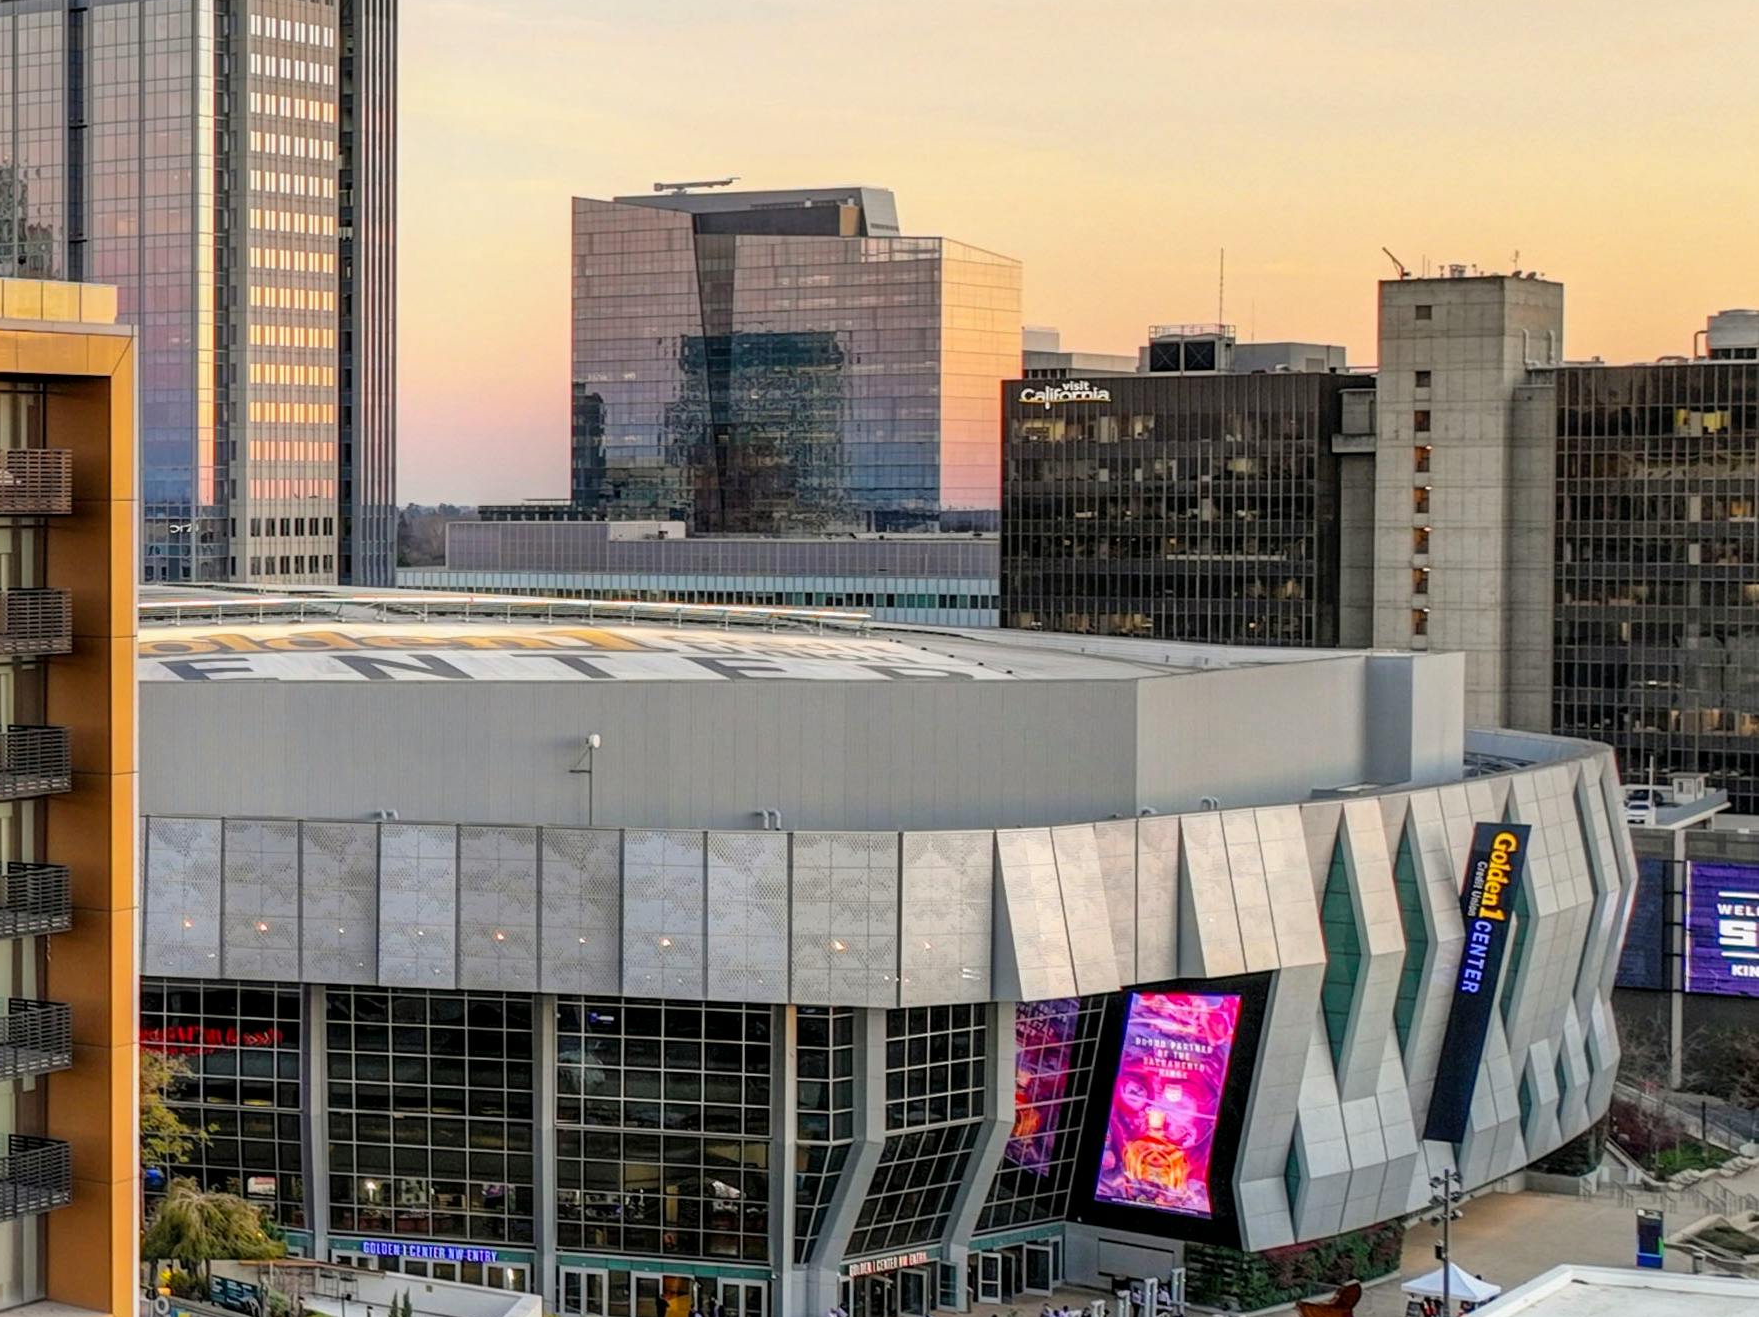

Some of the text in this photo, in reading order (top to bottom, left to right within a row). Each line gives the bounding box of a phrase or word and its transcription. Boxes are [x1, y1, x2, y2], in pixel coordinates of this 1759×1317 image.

[1062, 380, 1090, 391] visit
[1020, 385, 1111, 410] California
[1468, 860, 1488, 917] Credit Union
[1462, 920, 1493, 994] CENTER
[1170, 1040, 1213, 1054] PARTNER
[1173, 1051, 1190, 1060] THE
[1143, 1056, 1205, 1072] SACRAMENTO
[363, 1241, 400, 1256] GOLDEN
[409, 1245, 445, 1259] CENTER
[448, 1247, 464, 1260] NW
[467, 1249, 497, 1263] ENTRY
